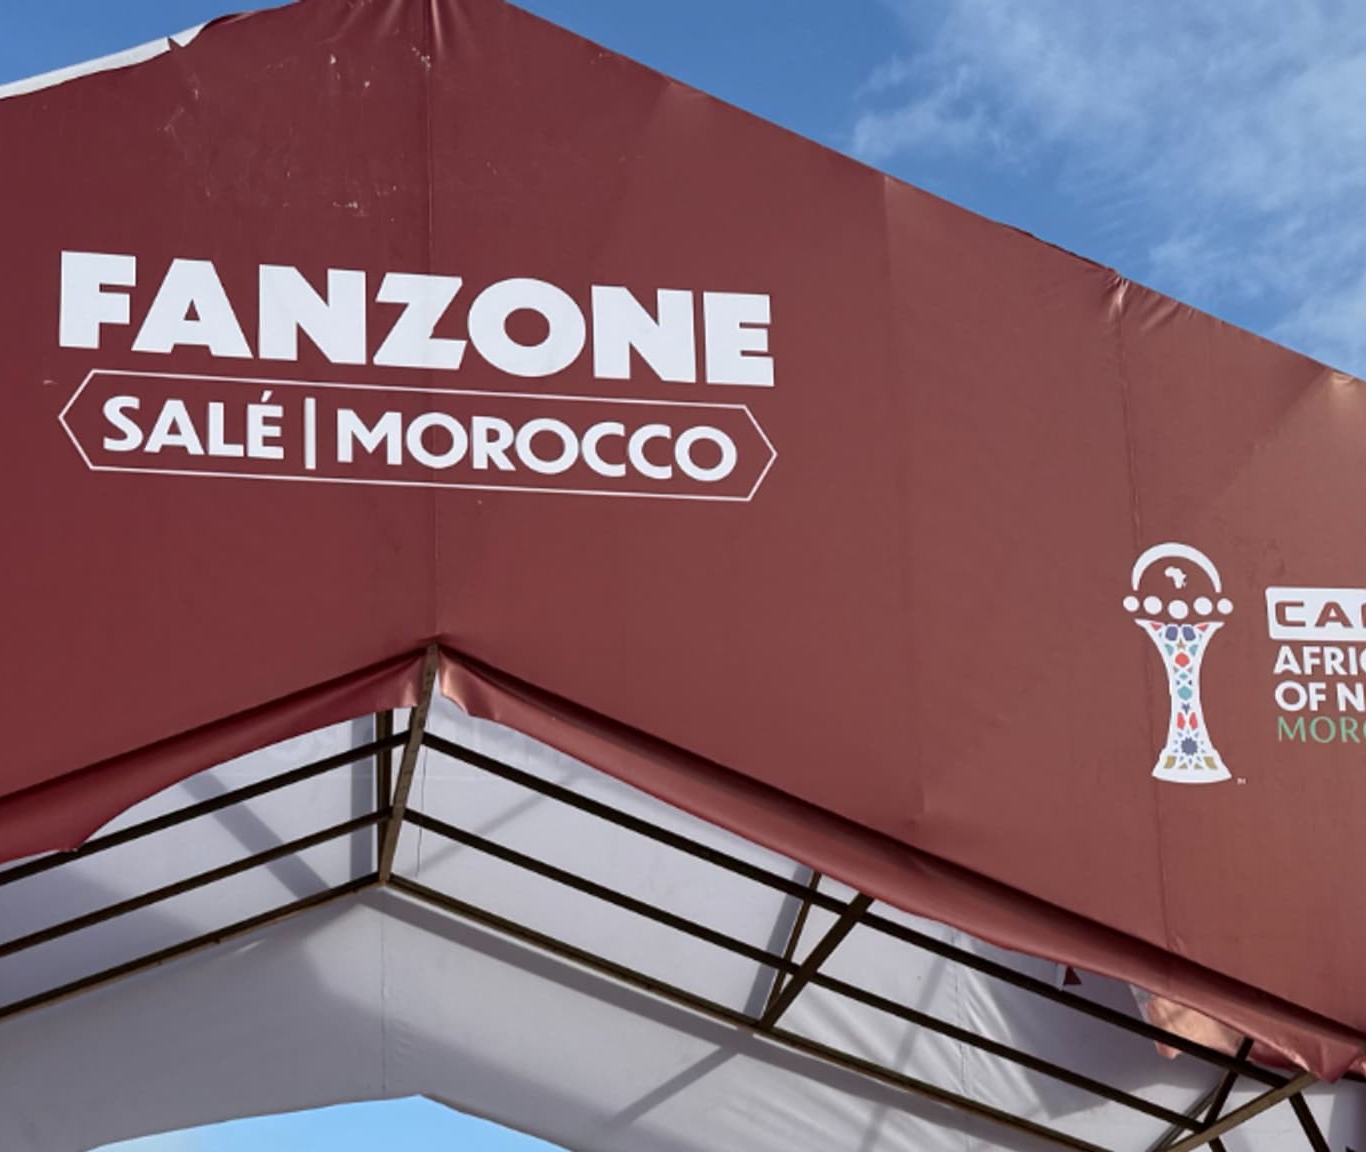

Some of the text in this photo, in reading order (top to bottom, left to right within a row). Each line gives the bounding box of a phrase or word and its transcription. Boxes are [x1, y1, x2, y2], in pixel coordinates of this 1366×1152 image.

[59, 250, 775, 387] FANZONE
[102, 390, 737, 481] SALÉ MOROCCO
[1274, 681, 1327, 712] OF
